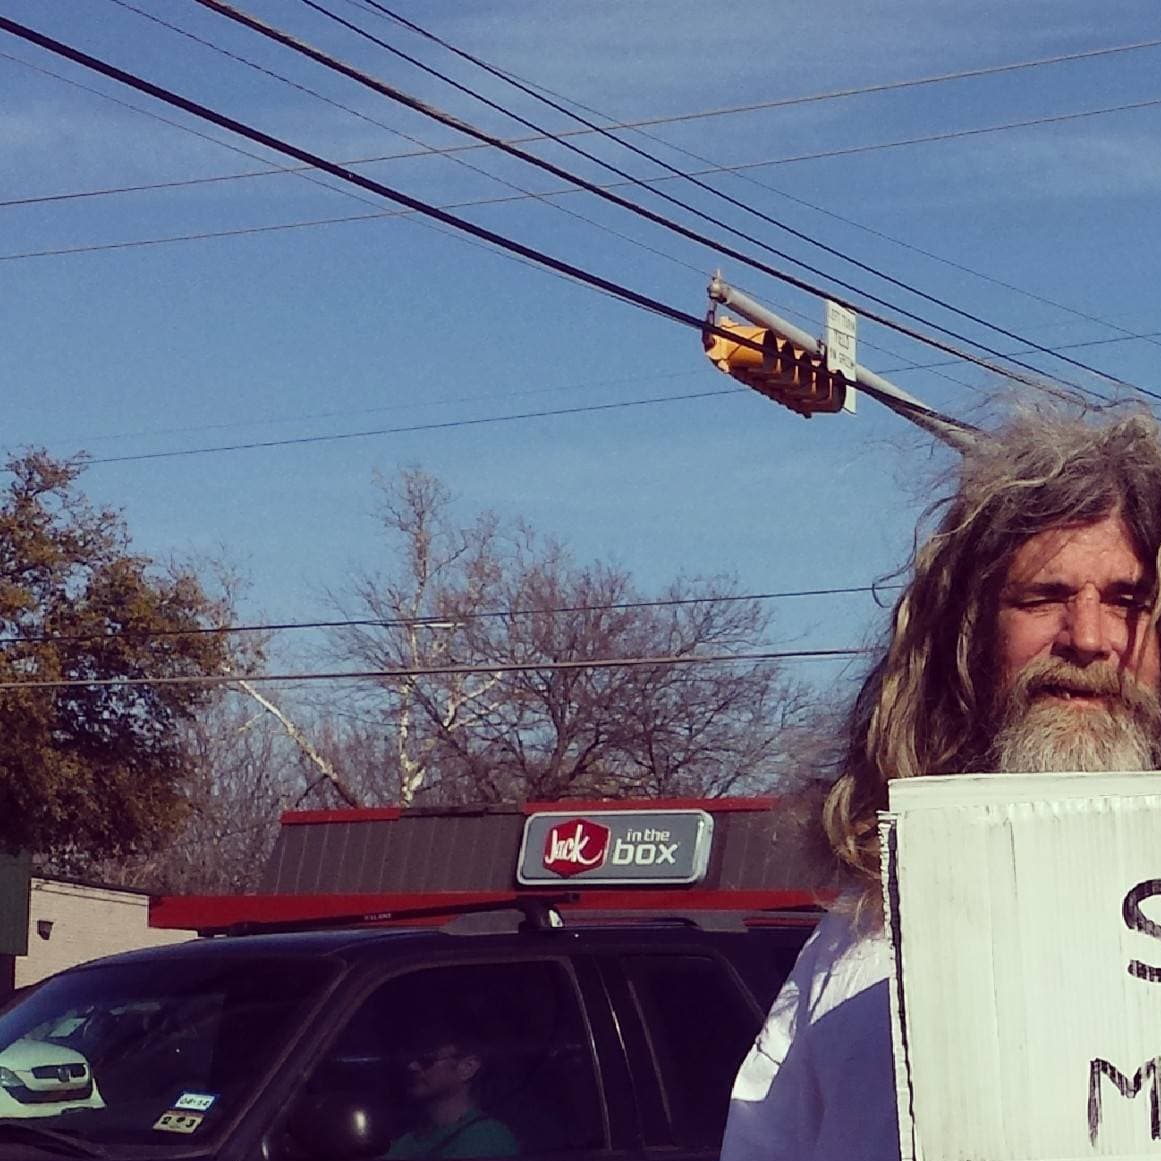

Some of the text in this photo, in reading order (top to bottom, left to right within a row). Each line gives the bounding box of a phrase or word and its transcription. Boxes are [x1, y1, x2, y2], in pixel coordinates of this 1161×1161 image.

[544, 824, 603, 865] Jack
[627, 829, 670, 842] in the
[612, 839, 678, 865] box
